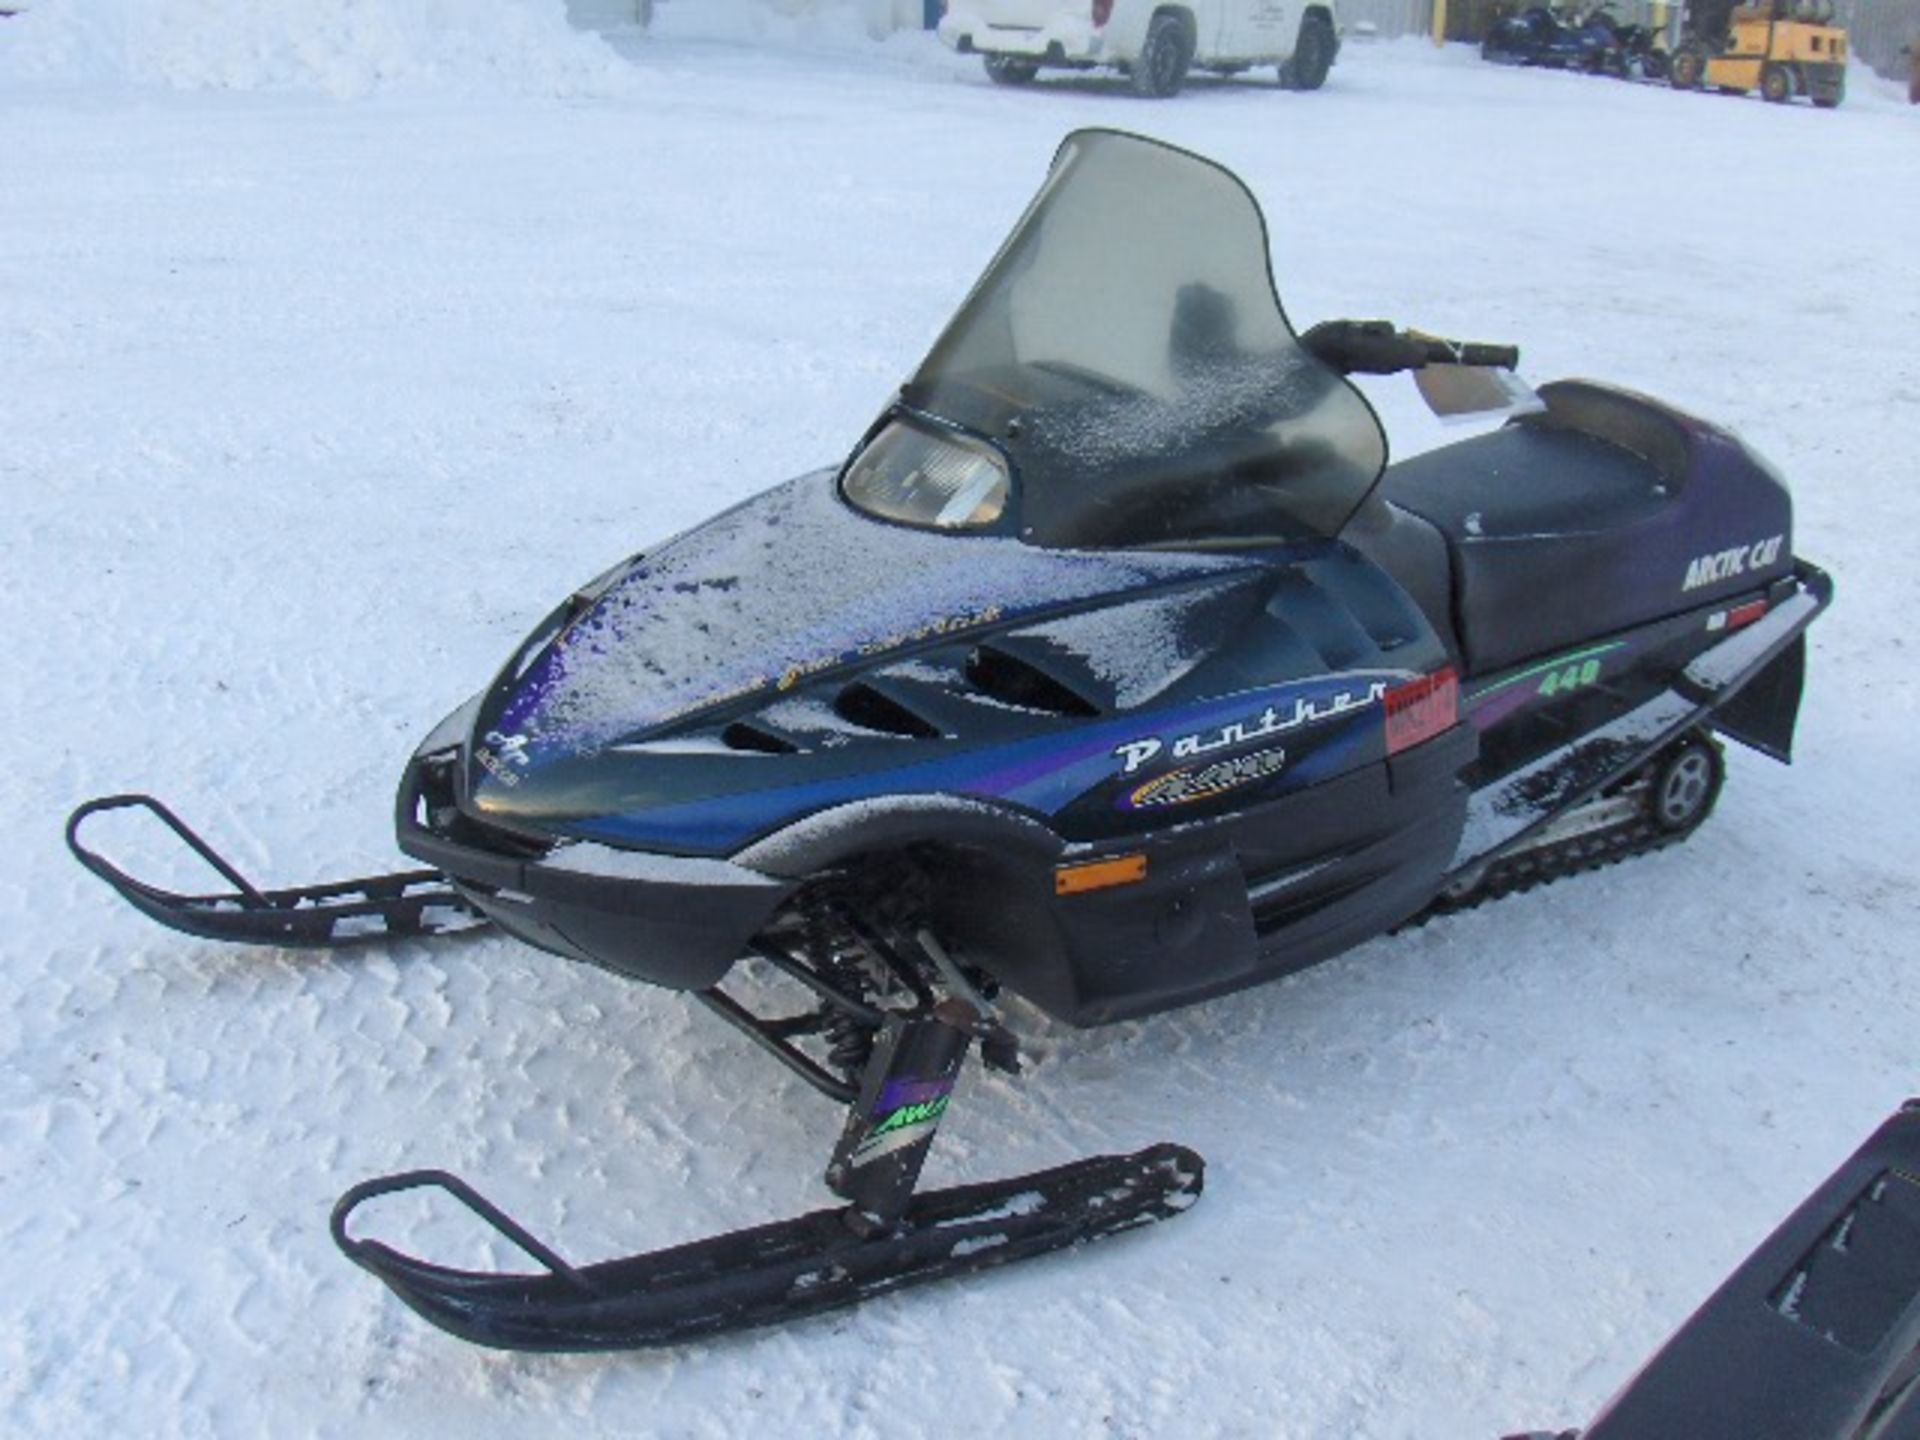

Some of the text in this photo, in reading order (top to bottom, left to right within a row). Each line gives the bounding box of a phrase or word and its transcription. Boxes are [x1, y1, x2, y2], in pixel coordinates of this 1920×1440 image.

[1682, 534, 1783, 592] ARCTIC CAT
[1537, 659, 1600, 696] 440
[1114, 681, 1387, 772] Panther
